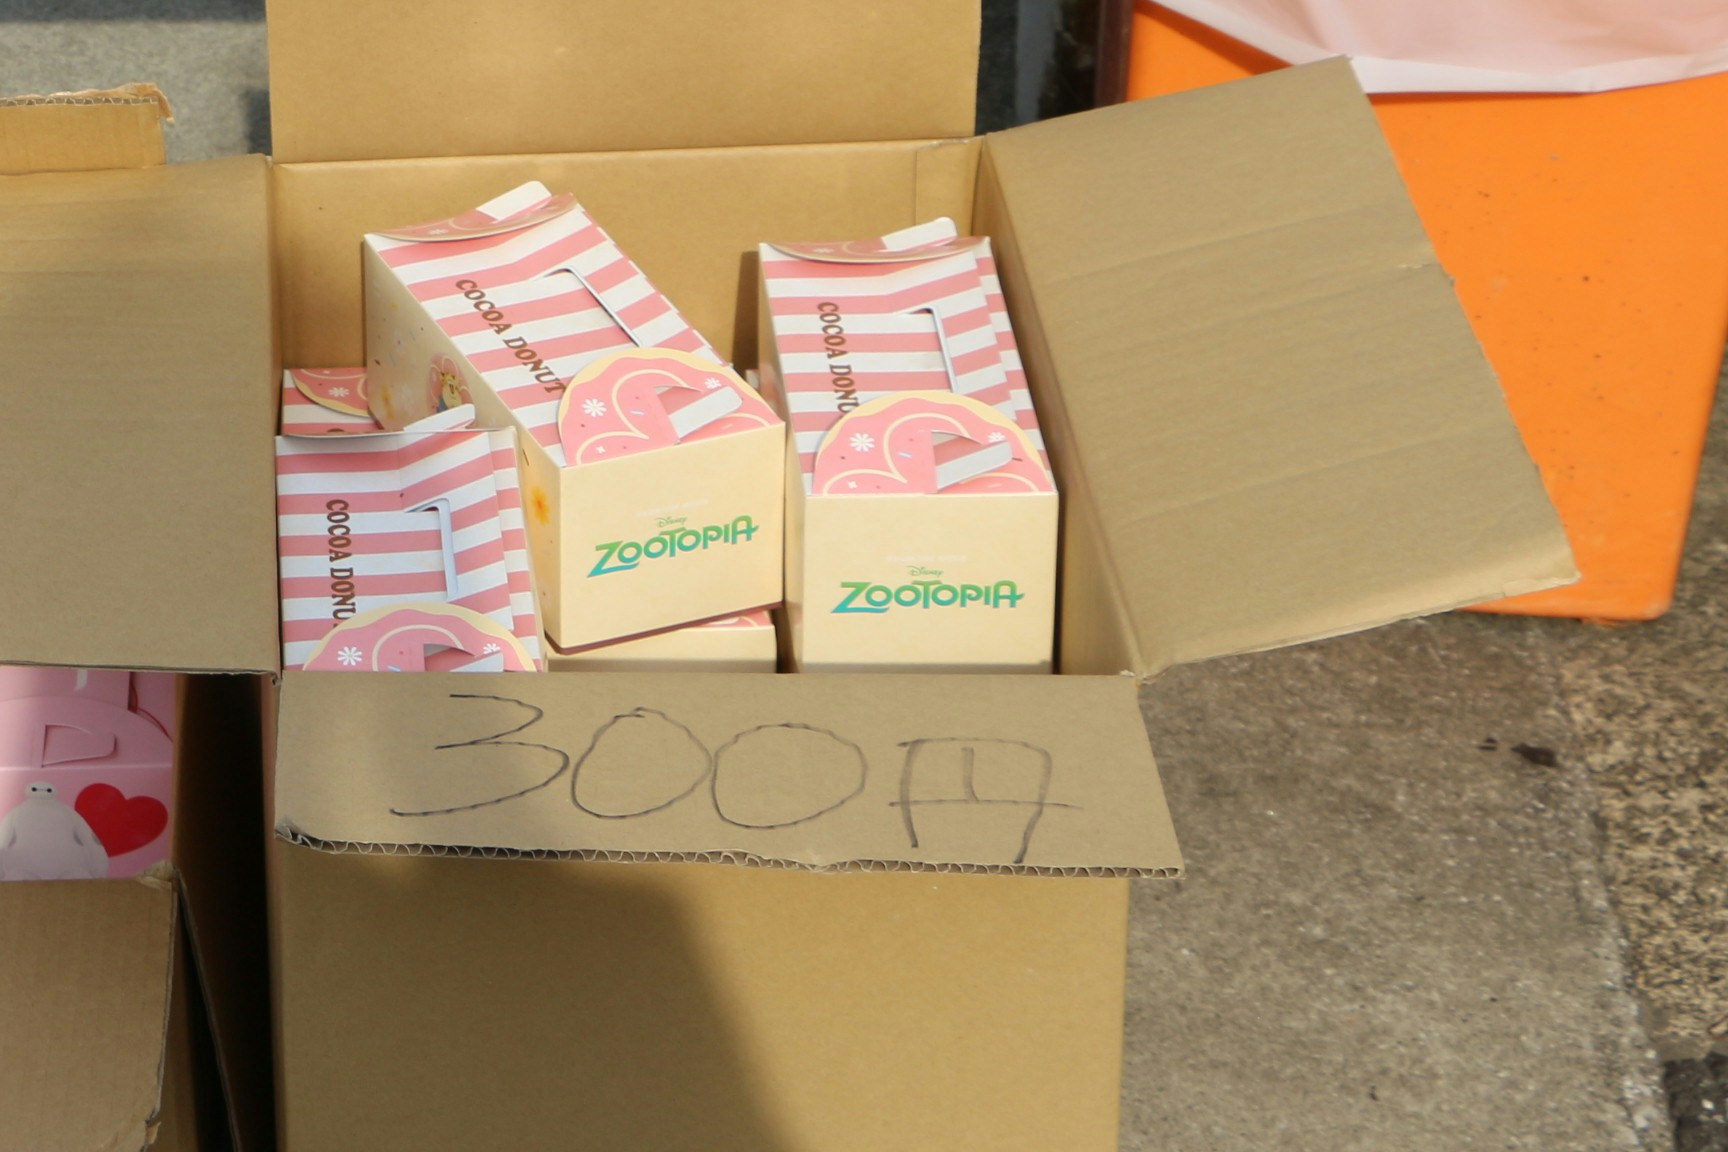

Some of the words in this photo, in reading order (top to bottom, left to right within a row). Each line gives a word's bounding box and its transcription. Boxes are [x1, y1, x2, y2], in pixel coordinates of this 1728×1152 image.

[455, 279, 513, 335] COCOA
[817, 301, 849, 359] COCOA
[829, 364, 860, 415] DONU
[325, 498, 353, 563] COCOA
[586, 515, 760, 578] ZOOTOPIA
[655, 516, 688, 528] Disney
[330, 567, 357, 628] DONU
[830, 579, 1026, 614] ZOOTOPIA
[906, 565, 945, 578] Disney
[390, 692, 1083, 864] 300円
